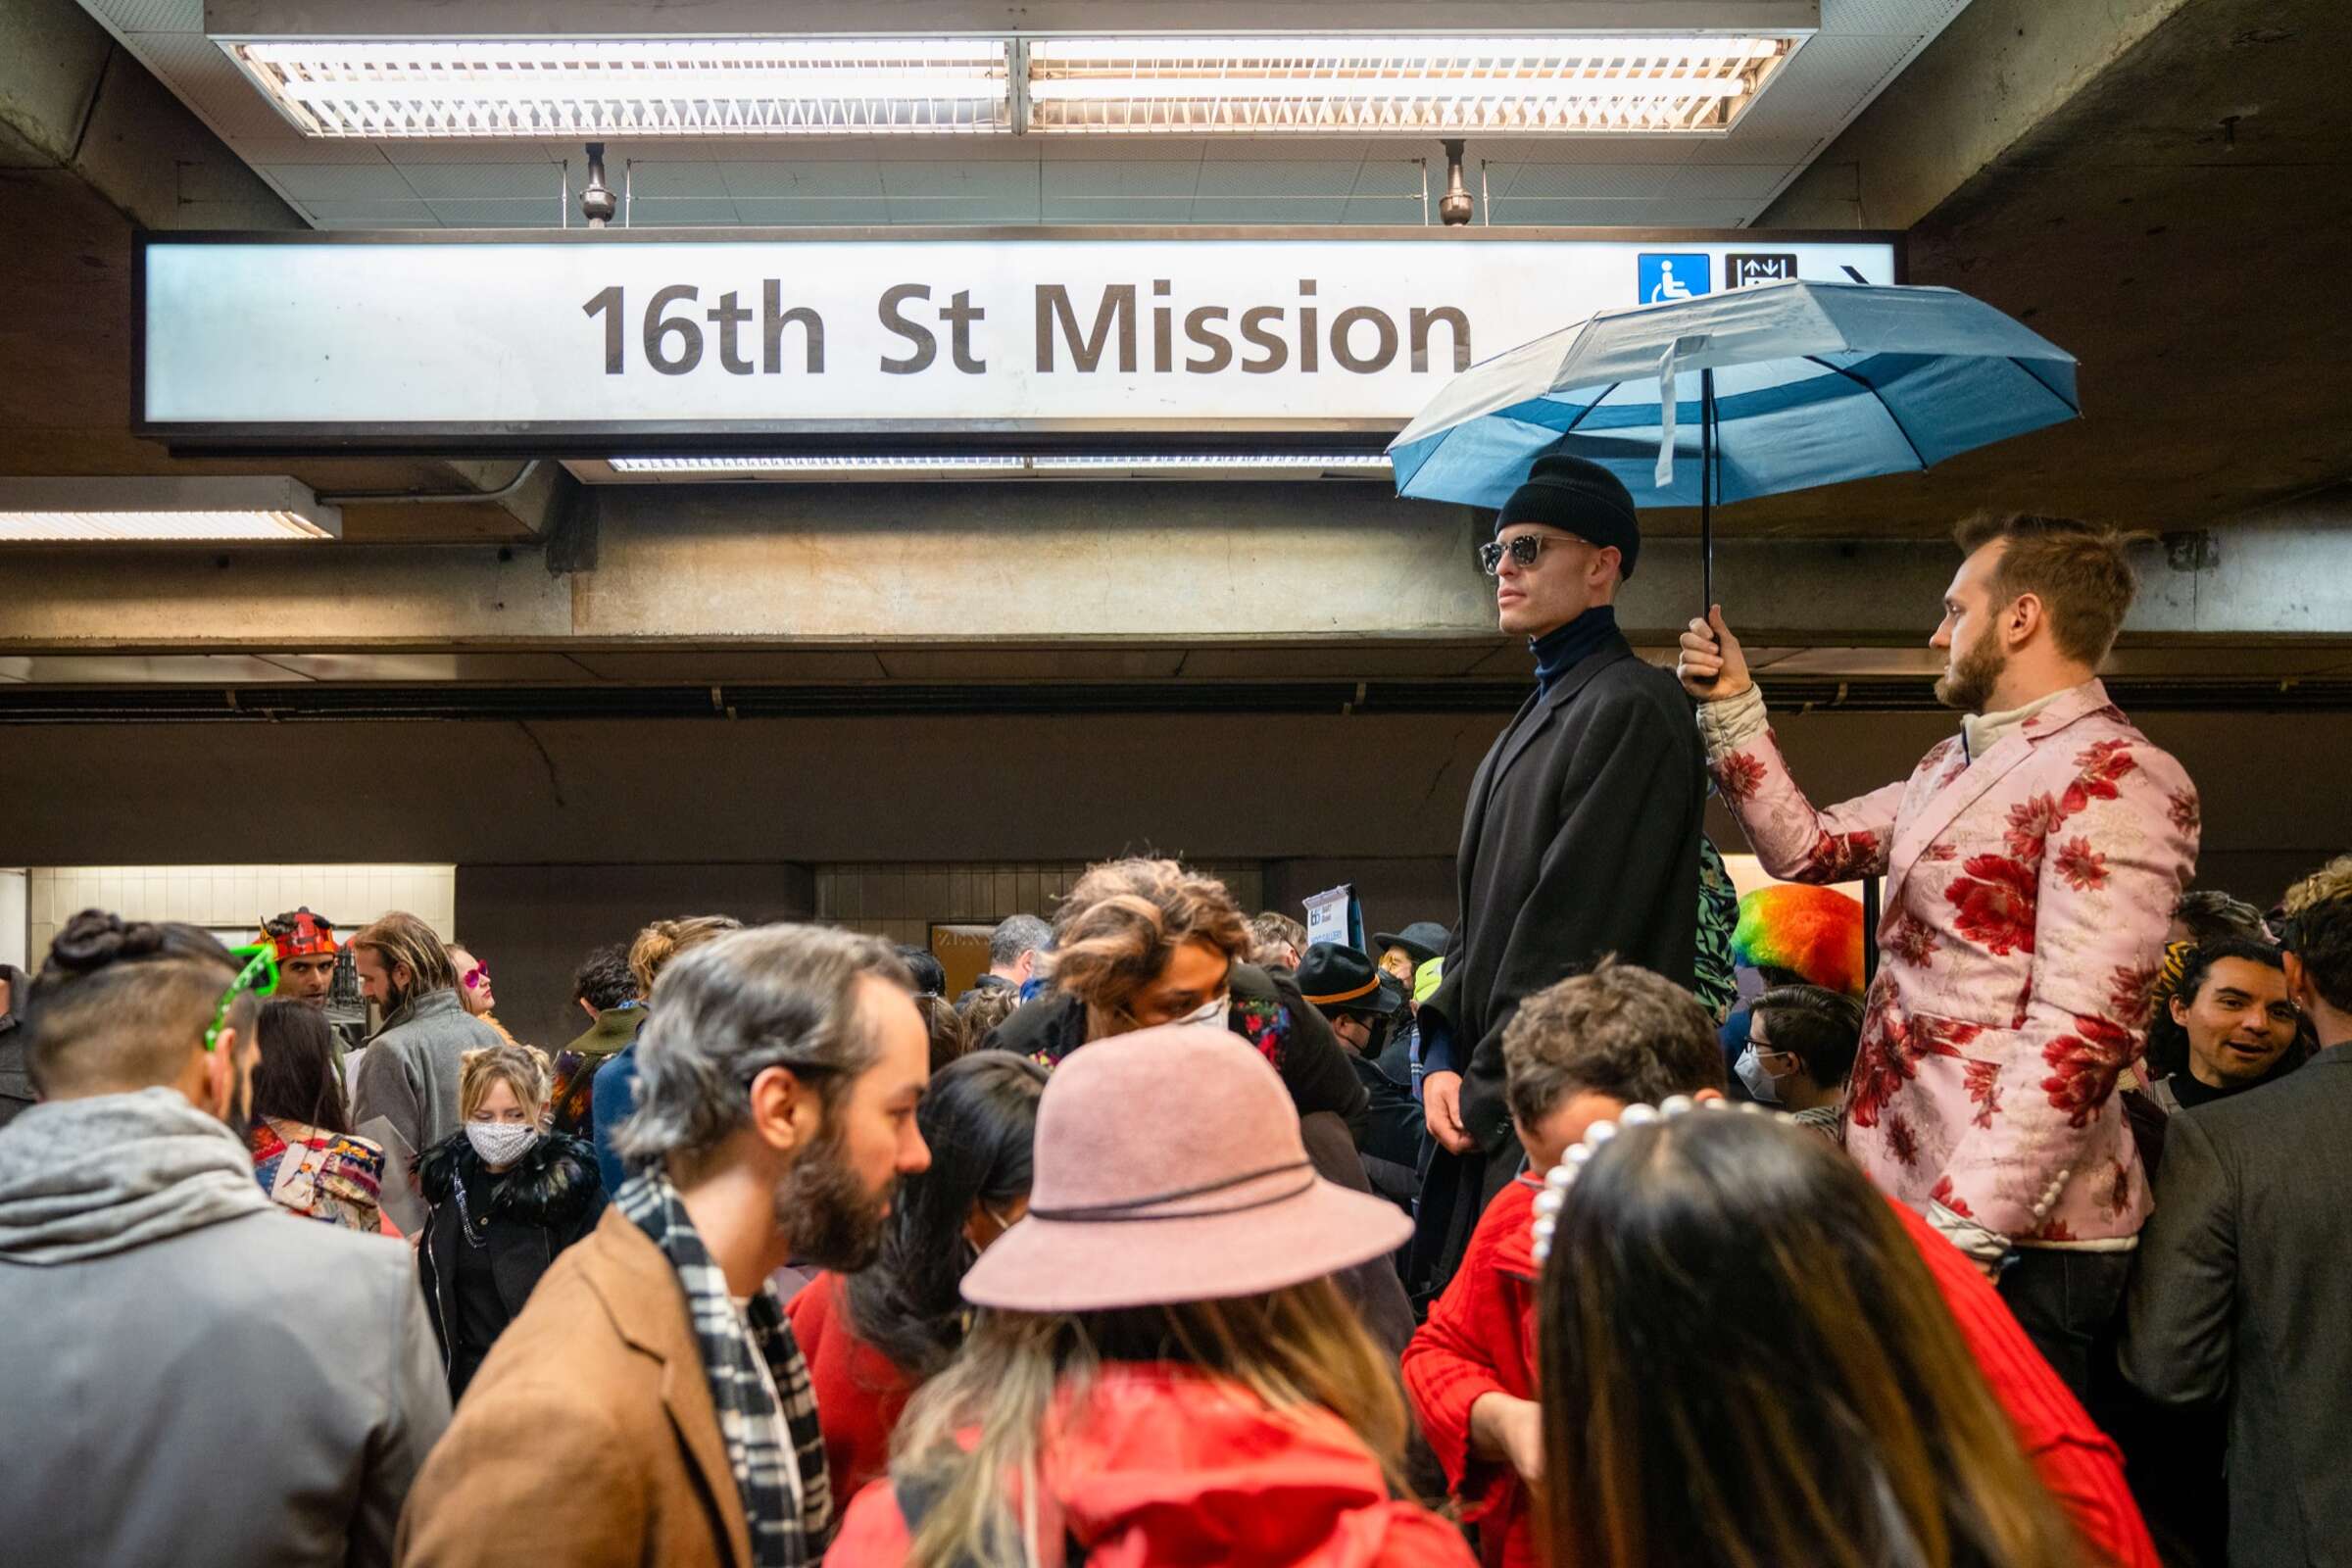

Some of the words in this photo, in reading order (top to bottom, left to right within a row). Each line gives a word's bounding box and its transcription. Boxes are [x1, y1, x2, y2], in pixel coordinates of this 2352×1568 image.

[583, 279, 824, 375] 16th
[879, 284, 986, 374] St
[1036, 279, 1471, 373] Mission
